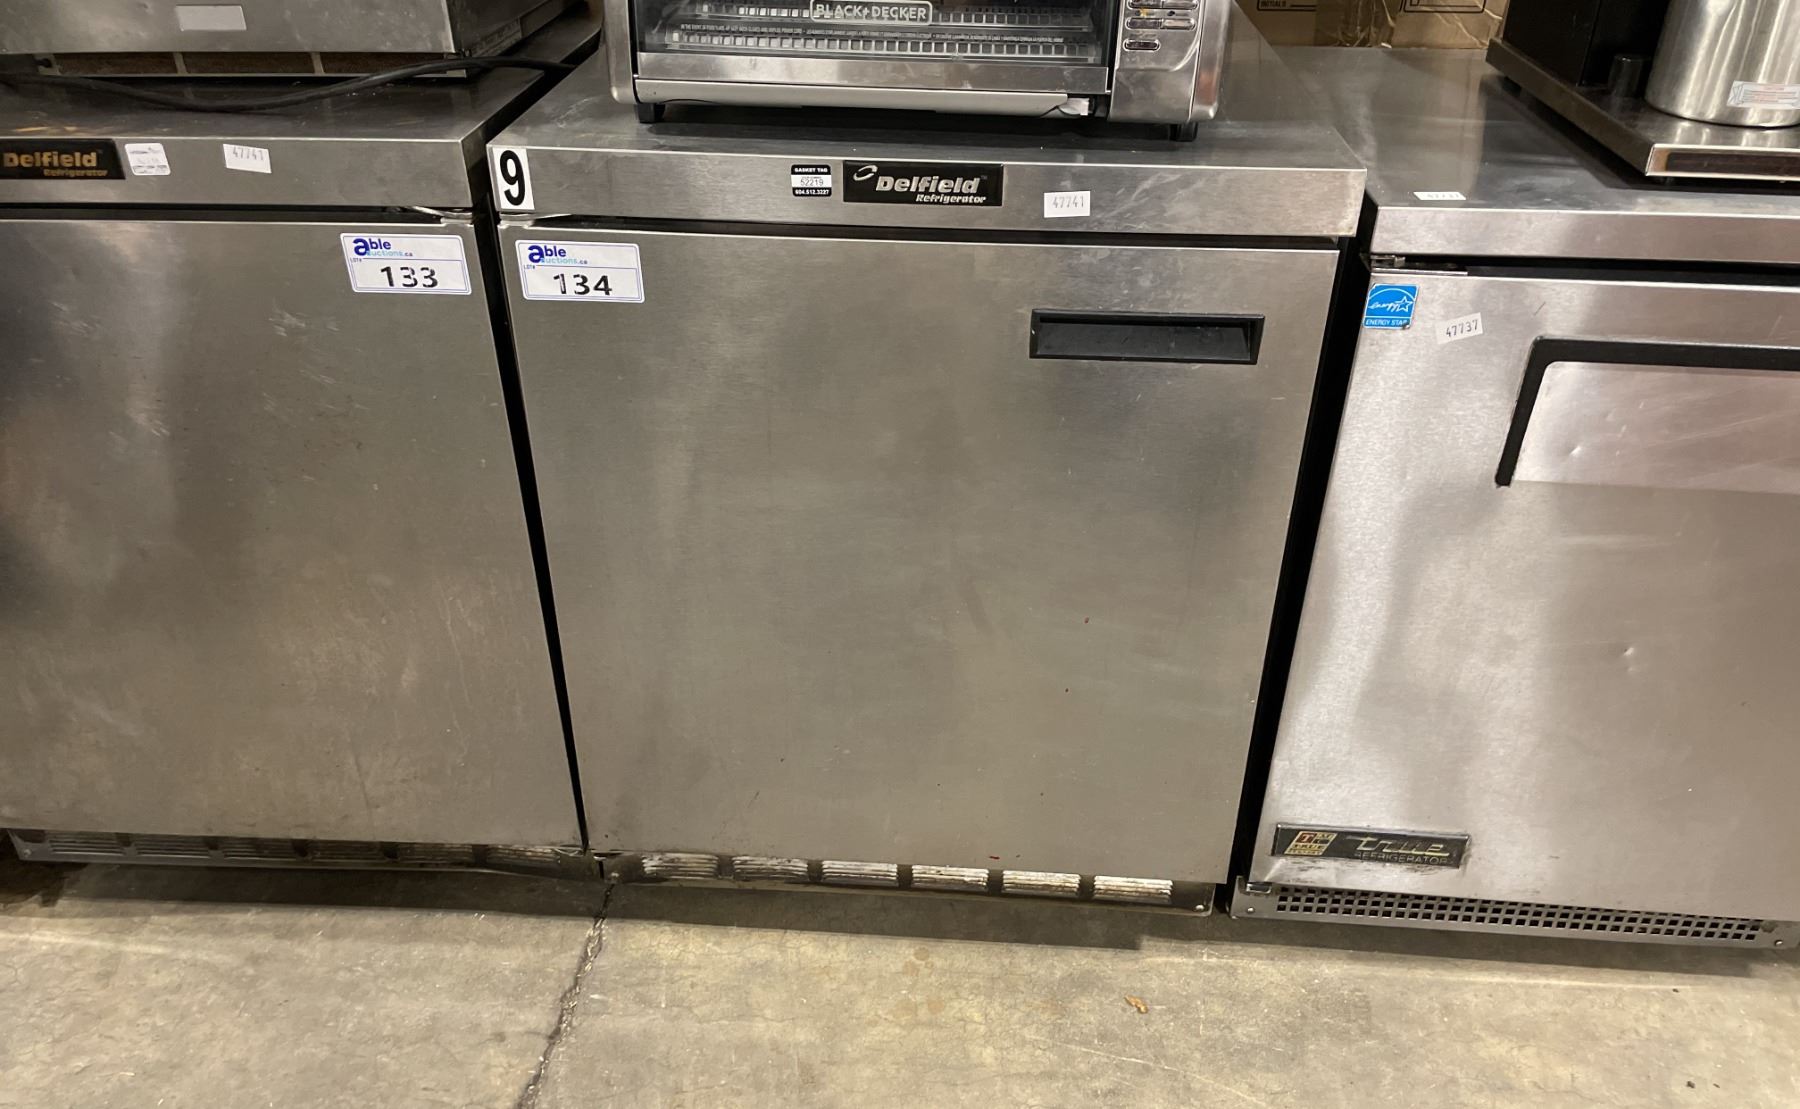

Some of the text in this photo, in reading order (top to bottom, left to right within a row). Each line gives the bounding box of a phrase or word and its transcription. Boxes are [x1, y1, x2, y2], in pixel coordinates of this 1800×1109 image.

[815, 3, 928, 20] BLACK+DECKER
[3, 151, 97, 167] Delfield
[500, 149, 526, 206] 9
[875, 175, 981, 193] Delfield
[915, 193, 987, 204] Refrigerator
[1052, 194, 1084, 209] 47741
[380, 265, 438, 289] 133
[553, 273, 613, 296] 134
[1446, 319, 1478, 337] 47737
